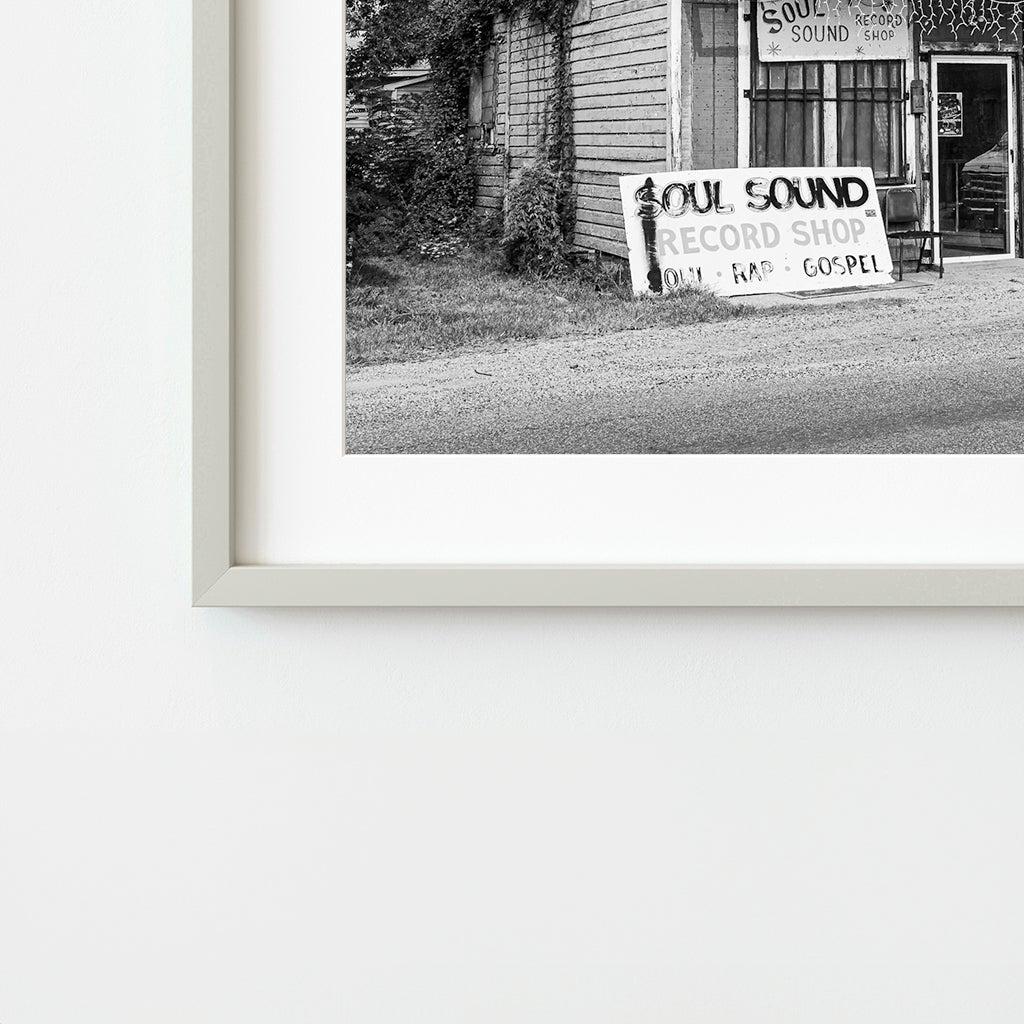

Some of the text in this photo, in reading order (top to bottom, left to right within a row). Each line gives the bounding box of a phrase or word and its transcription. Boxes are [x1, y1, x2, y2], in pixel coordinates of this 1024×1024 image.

[855, 14, 902, 28] RECORD
[791, 25, 849, 43] SOUND
[864, 30, 894, 41] SHOP
[634, 176, 869, 219] SOUL SOUND
[658, 218, 866, 256] RECORD SHOP
[732, 260, 774, 285] RAP
[803, 254, 885, 278] GOSPEL
